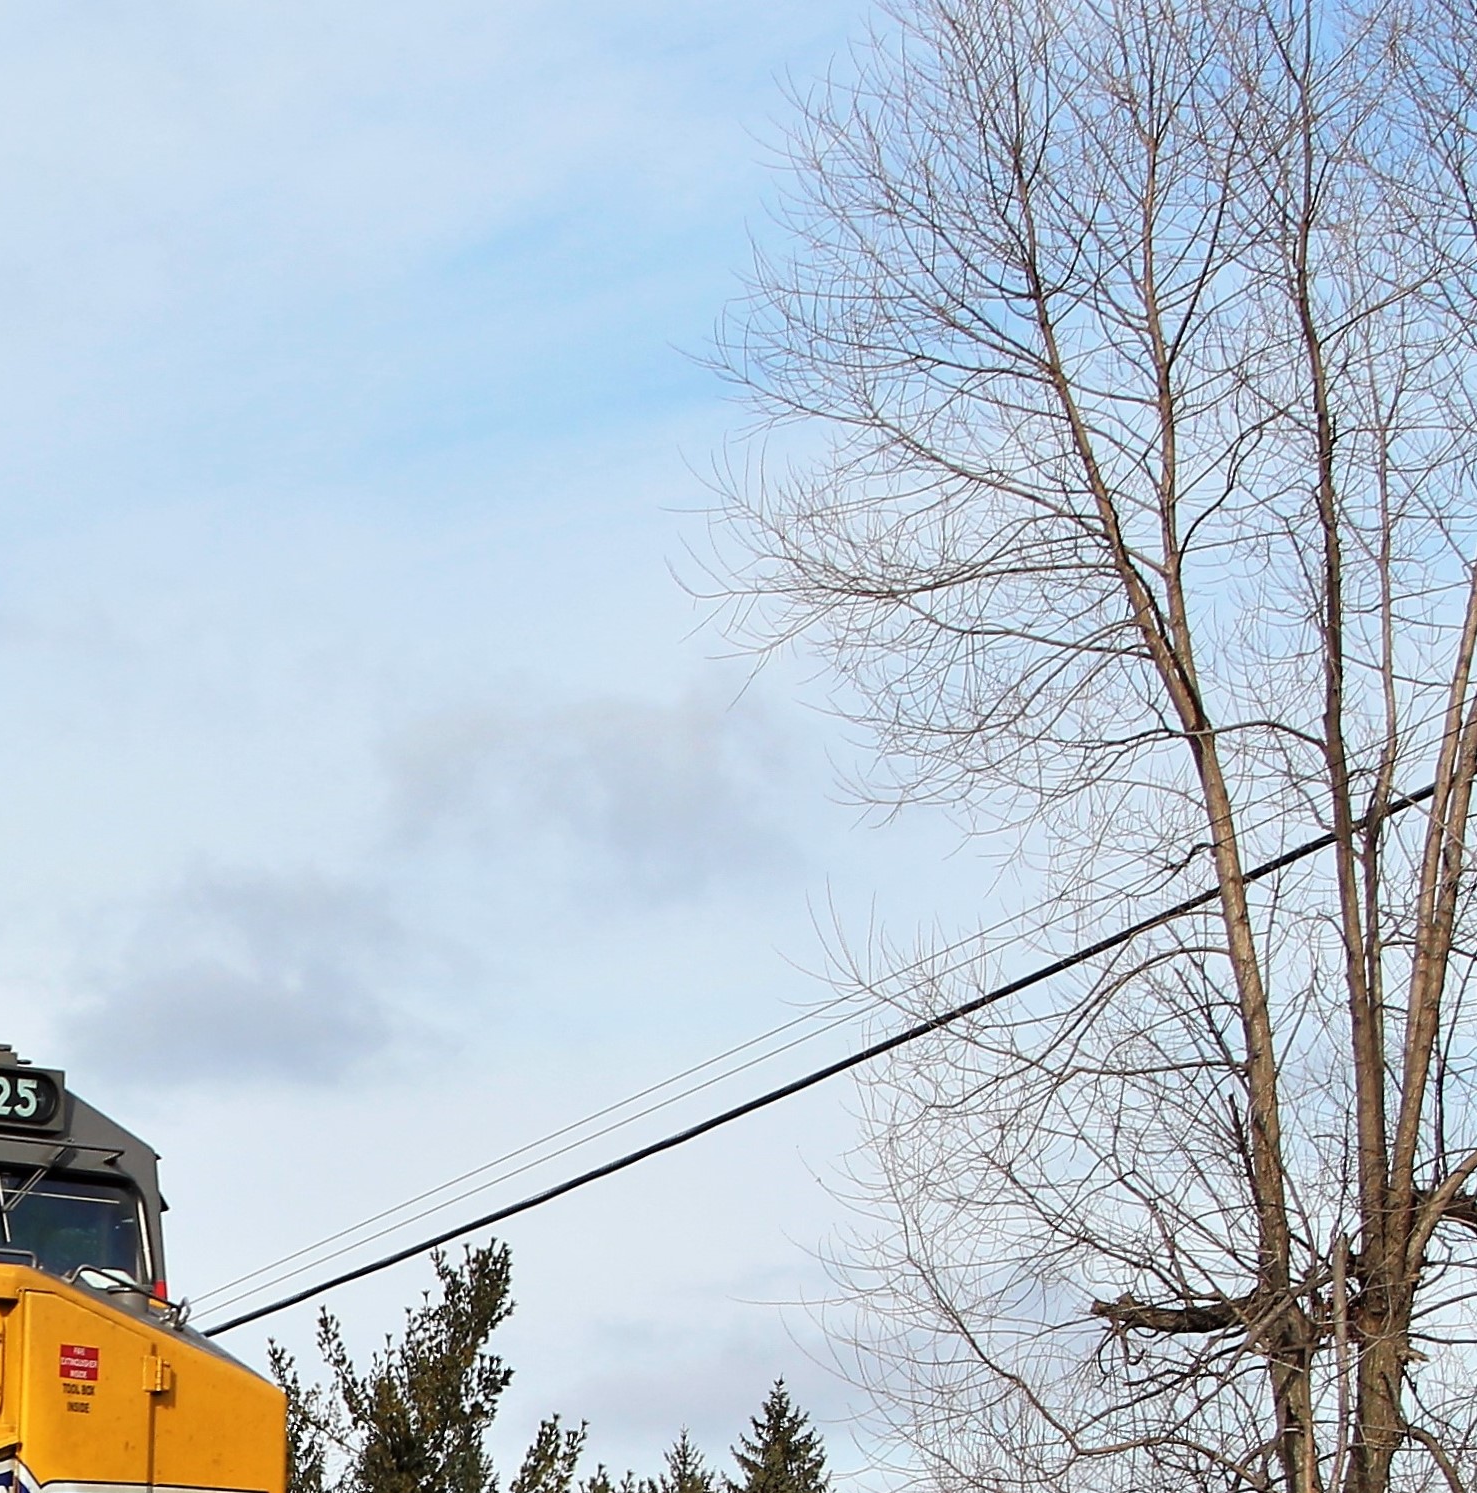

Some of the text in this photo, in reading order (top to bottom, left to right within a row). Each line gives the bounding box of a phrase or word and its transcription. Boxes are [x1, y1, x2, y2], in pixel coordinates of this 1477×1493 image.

[62, 1382, 95, 1396] TOOL BOX
[67, 1401, 90, 1414] INSIDE
